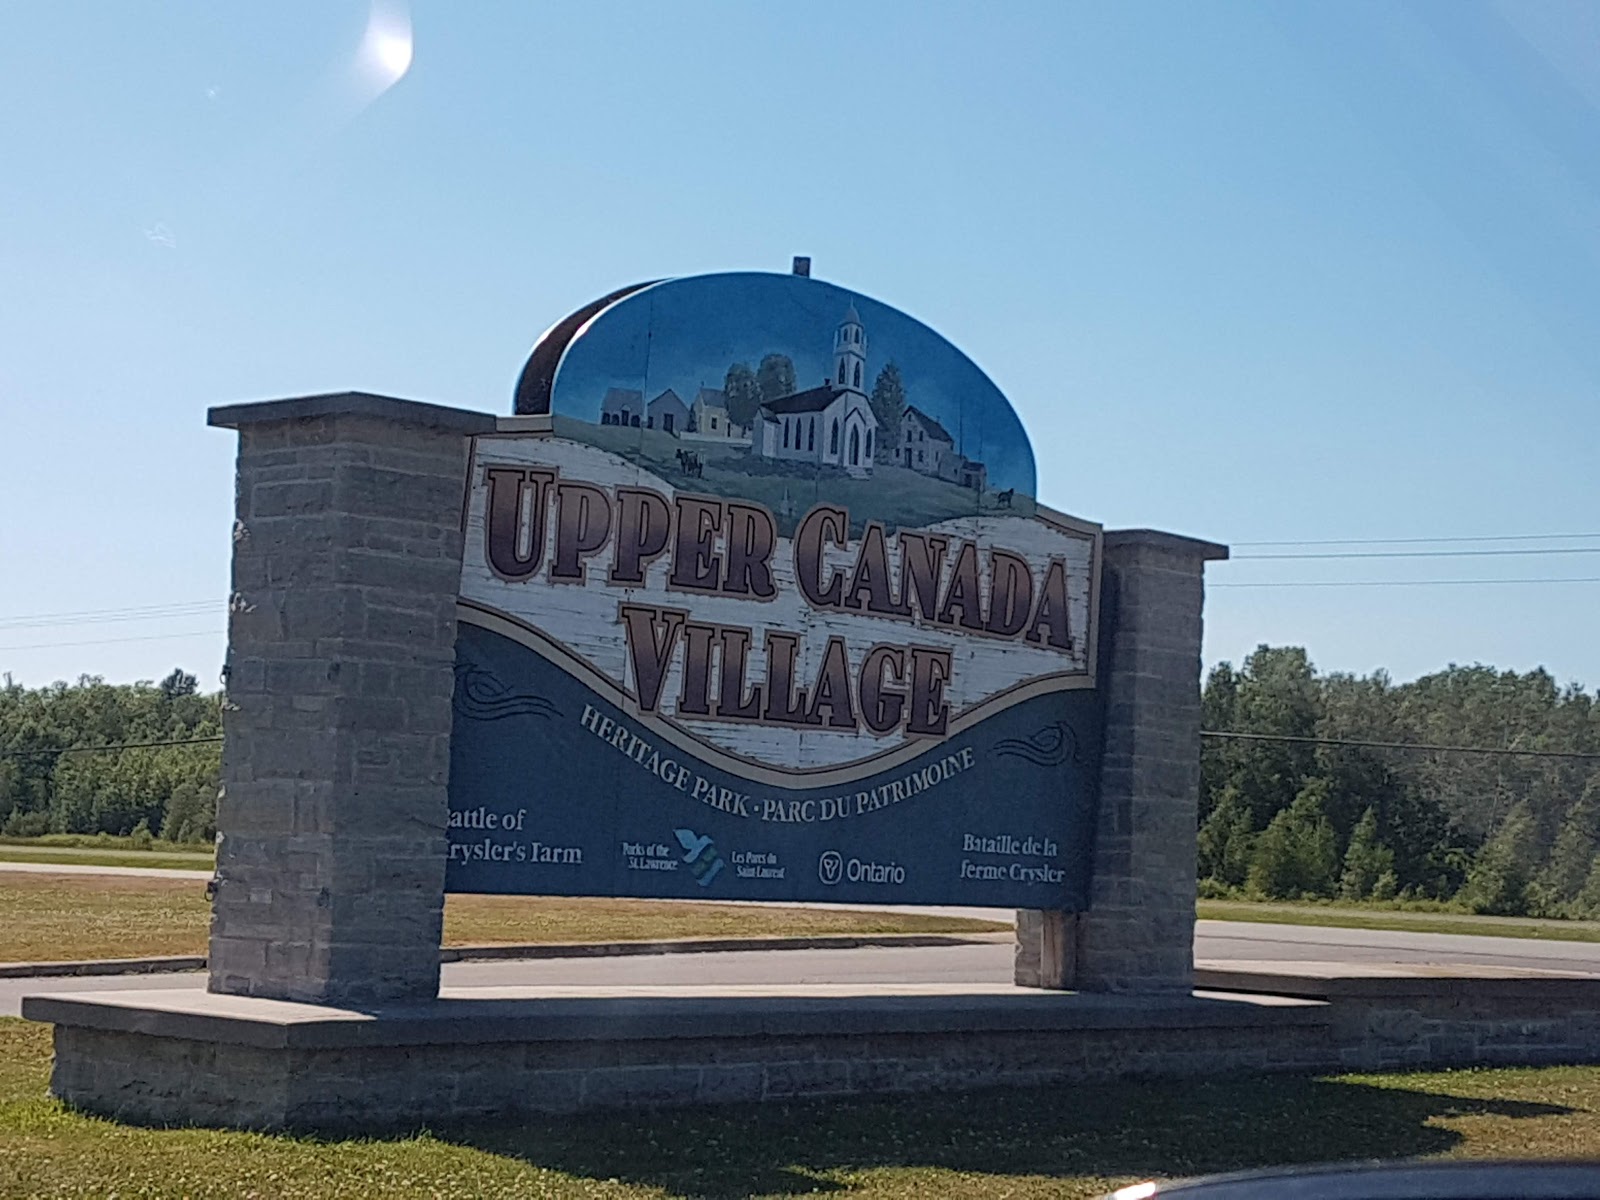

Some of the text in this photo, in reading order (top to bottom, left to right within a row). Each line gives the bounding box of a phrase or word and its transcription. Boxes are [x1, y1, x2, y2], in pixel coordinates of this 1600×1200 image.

[483, 464, 1075, 654] UPPER CANADA
[617, 602, 952, 739] VILLAGE
[580, 703, 975, 823] HERITAGE PARK PARC DU PATRIMOINE
[502, 808, 527, 831] of
[447, 838, 583, 867] rysler's Farm
[622, 841, 670, 858] Parks of the
[731, 850, 777, 865] Les Parcs du
[963, 833, 1058, 857] Bataille de la
[639, 857, 679, 871] Lawrence
[847, 858, 905, 884] Ontario
[960, 859, 1066, 886] ferme Crysler
